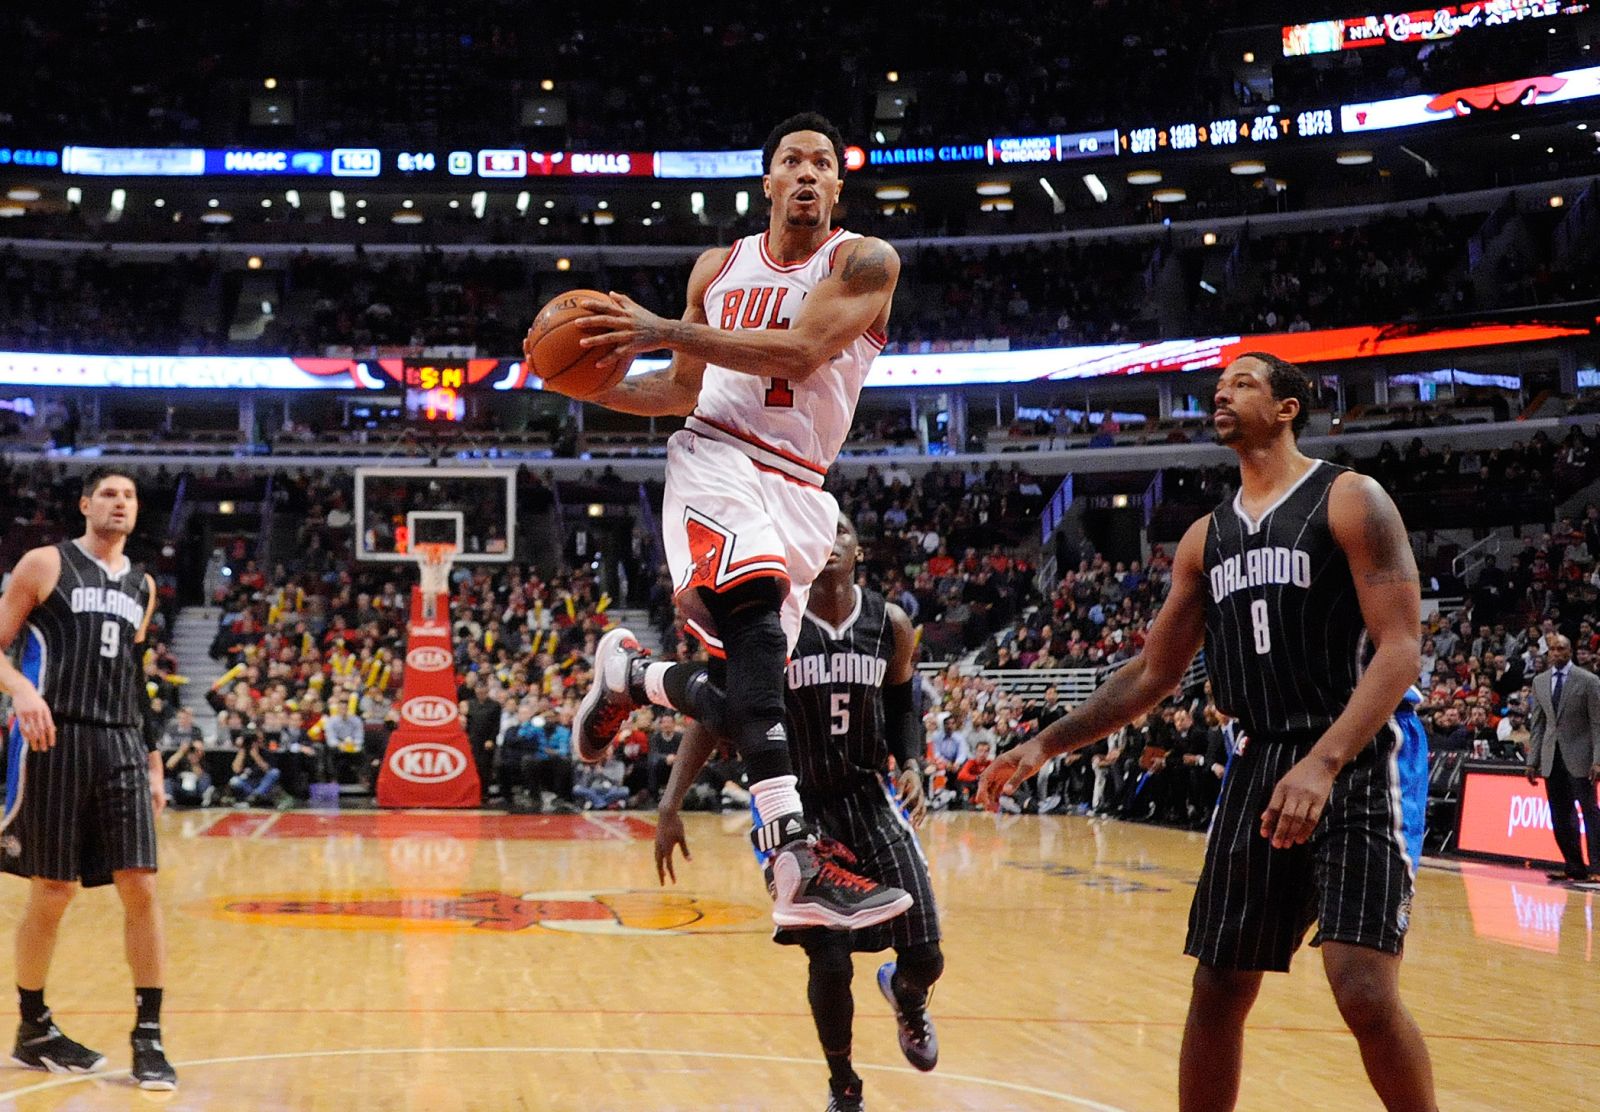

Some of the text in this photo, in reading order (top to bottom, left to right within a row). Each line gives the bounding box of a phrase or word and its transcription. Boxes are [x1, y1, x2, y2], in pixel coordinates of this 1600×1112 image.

[1485, 3, 1558, 26] APPLE
[1350, 22, 1386, 40] NEW
[1198, 126, 1207, 142] 3
[1240, 122, 1249, 138] 4
[1280, 118, 1290, 134] T
[1001, 137, 1051, 151] ORLANDO
[1120, 135, 1127, 150] 1
[1158, 131, 1167, 146] 2
[225, 152, 287, 171] MAGIC
[570, 153, 631, 173] BULLS
[870, 145, 984, 165] HARRIS CLUB
[1001, 149, 1051, 163] CHICAGO
[721, 287, 805, 331] BUL
[1210, 546, 1311, 604] ORLANDO
[71, 586, 144, 631] ORLANDO
[1251, 598, 1271, 655] 8
[99, 620, 120, 658] 9
[413, 652, 446, 664] KIA
[787, 652, 887, 690] ORLANDO
[410, 704, 449, 720] KIA
[830, 693, 850, 735] 5
[403, 750, 454, 775] KIA
